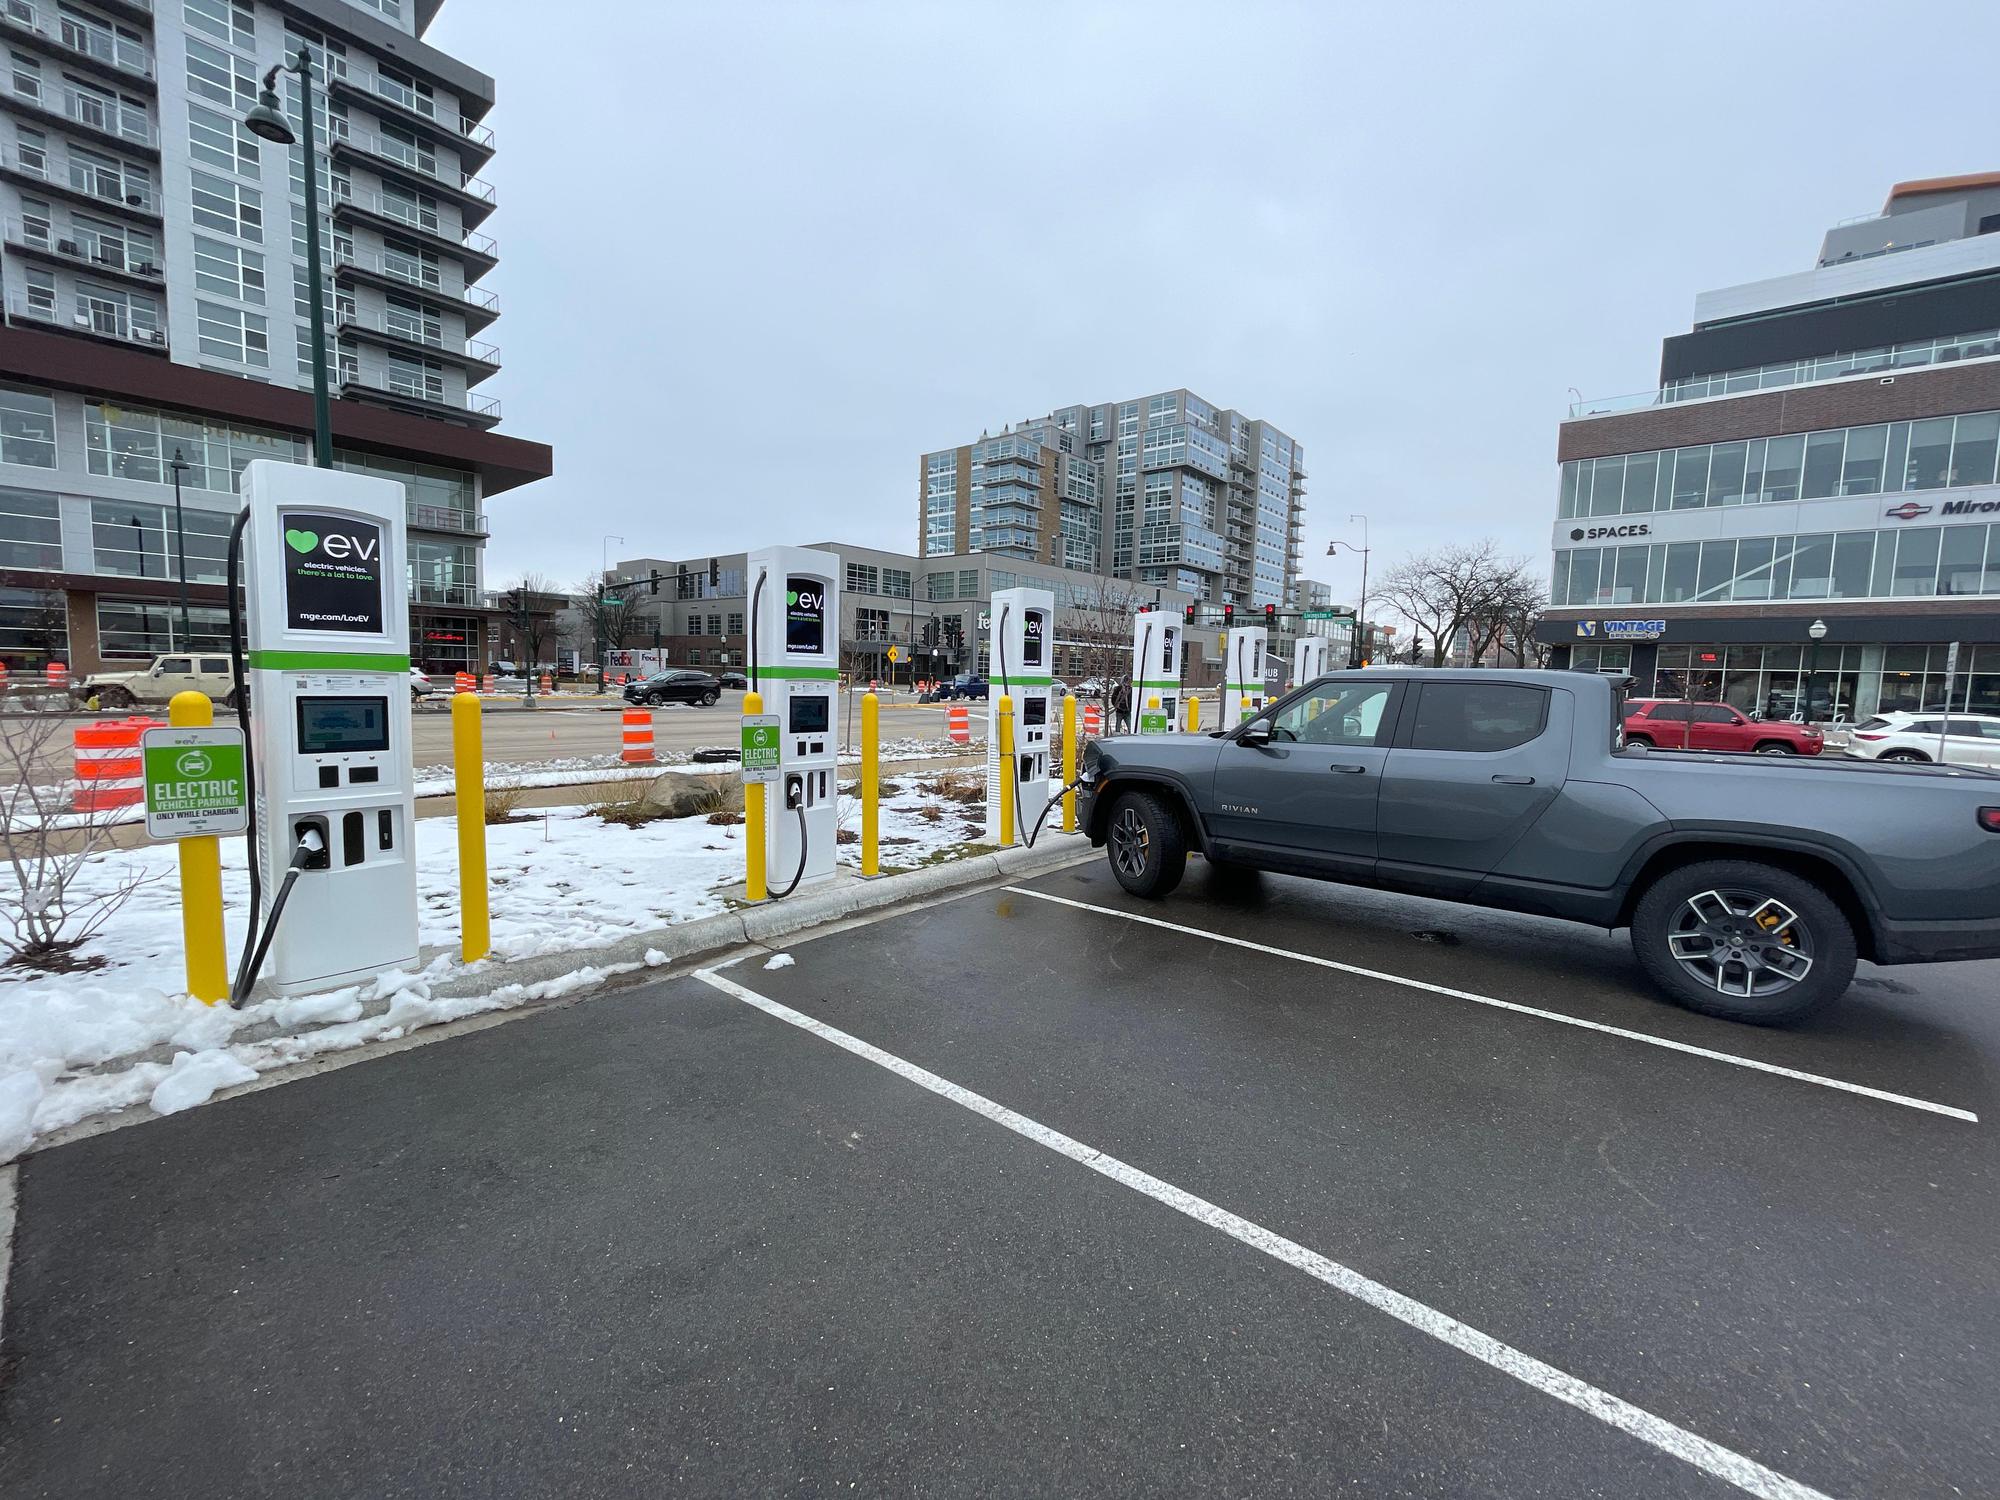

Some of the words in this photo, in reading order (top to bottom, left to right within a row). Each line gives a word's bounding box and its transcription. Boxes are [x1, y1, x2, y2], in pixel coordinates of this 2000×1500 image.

[1588, 524, 1652, 539] SPACES.
[323, 534, 379, 561] ev.
[297, 568, 326, 577] there's
[334, 571, 345, 579] lot
[356, 573, 374, 581] love.
[304, 562, 334, 571] electric
[335, 564, 368, 573] vehicles.
[799, 592, 824, 610] ev.
[300, 613, 369, 622] mge.com/LovEV
[977, 611, 991, 630] fe
[1603, 620, 1666, 633] VINTAGE
[610, 651, 632, 666] FedEx
[745, 747, 778, 760] ELECTRIC
[155, 780, 239, 800] ELECTRIC
[155, 799, 197, 811] VEHICLE
[198, 796, 239, 808] PARKING
[1221, 804, 1258, 814] RIVIAN
[156, 812, 175, 820] ONLY
[176, 810, 200, 819] WHILE
[202, 807, 239, 817] CHARGING
